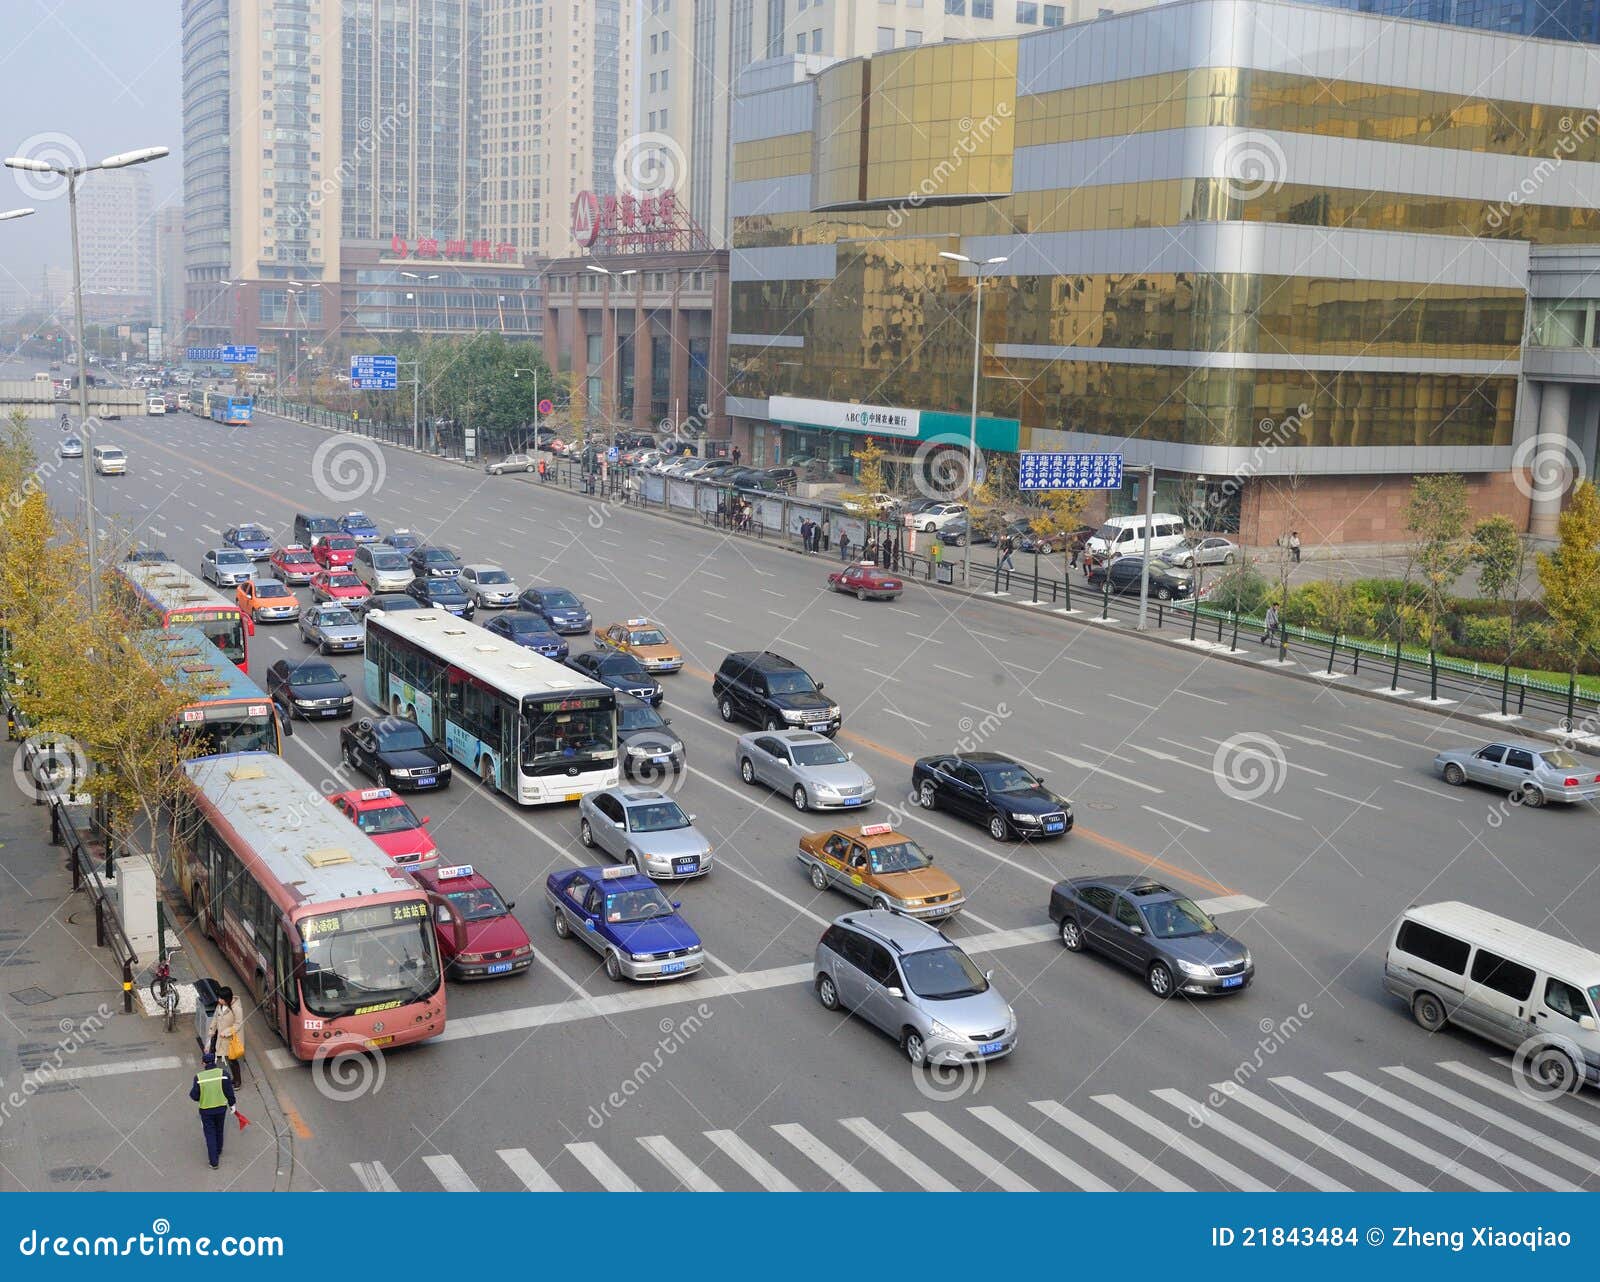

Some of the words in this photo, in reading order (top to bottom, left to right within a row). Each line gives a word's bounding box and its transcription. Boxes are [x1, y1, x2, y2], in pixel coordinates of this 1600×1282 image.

[846, 413, 860, 423] ABC
[394, 904, 428, 919] 北站站前
[306, 1021, 321, 1029] 114
